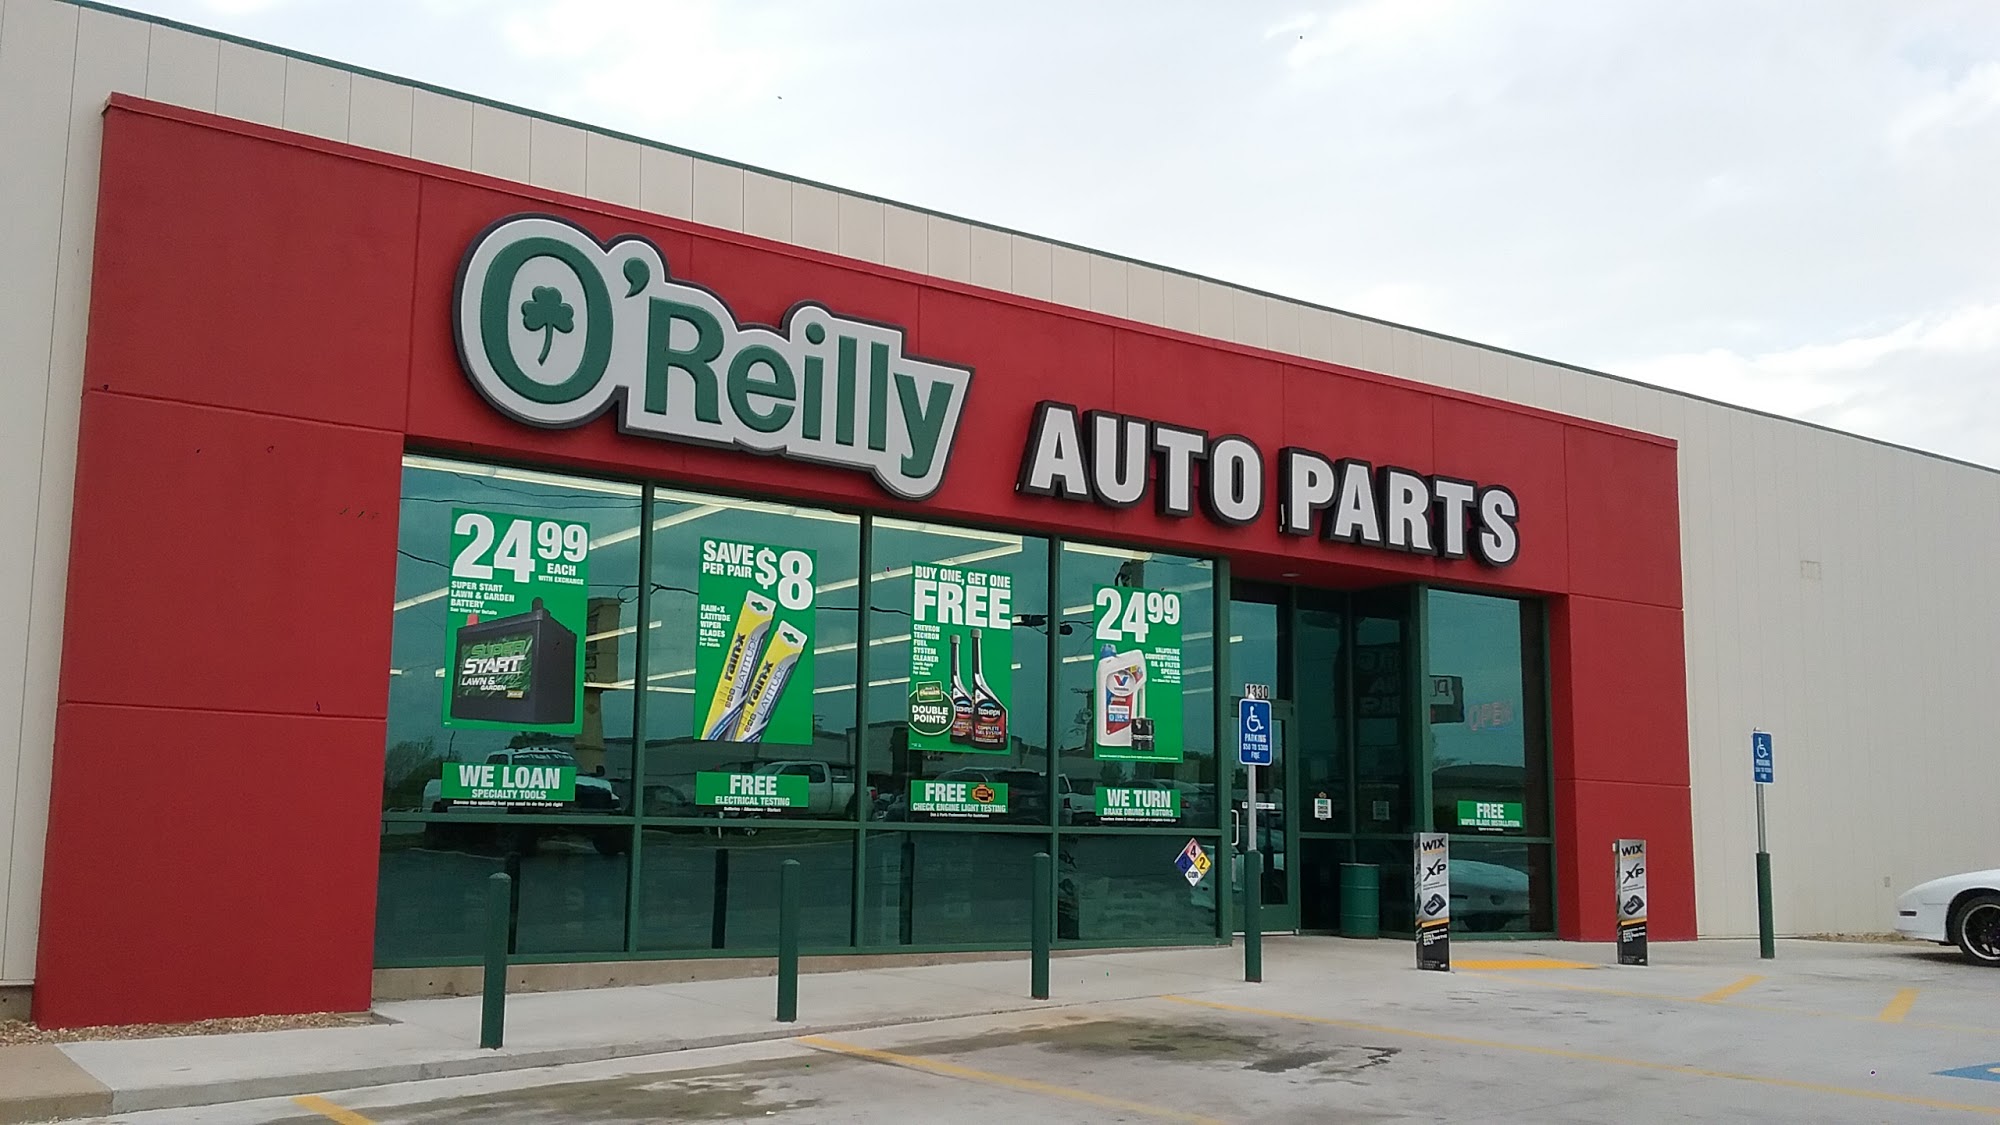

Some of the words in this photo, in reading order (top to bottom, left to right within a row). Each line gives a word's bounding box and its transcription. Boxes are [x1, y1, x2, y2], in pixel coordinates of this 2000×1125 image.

[480, 237, 954, 478] O'Reilly
[1029, 407, 1262, 520] AUTO
[1291, 453, 1517, 564] PARTS
[547, 563, 577, 576] EACH
[702, 562, 724, 575] PER
[727, 564, 752, 578] PAIR
[703, 540, 754, 566] SAVE
[755, 547, 814, 610] $8
[915, 565, 937, 579] BUY
[940, 568, 965, 585] ONE,
[967, 572, 987, 586] GET
[990, 575, 1011, 588] ONE
[451, 581, 477, 590] SUPER
[479, 583, 503, 592] START
[450, 589, 473, 598] LAWN
[475, 591, 482, 599] &
[483, 592, 515, 602] GARDEN
[450, 598, 485, 608] BATTERY
[914, 579, 1011, 630] FREE
[700, 612, 731, 622] LATITUDE
[700, 621, 722, 629] WIPER
[913, 623, 940, 632] CHEVRON
[699, 628, 726, 638] BLADES
[913, 631, 940, 640] TECHRON
[913, 639, 928, 647] FUEL
[913, 647, 936, 655] SYSTEM
[462, 654, 527, 674] START
[736, 636, 758, 690] LATITUDE
[913, 654, 939, 663] CLEANER
[461, 677, 487, 686] LAWN
[487, 676, 495, 685] &
[757, 665, 786, 717] LATITUDE
[1246, 684, 1269, 698] 1330
[912, 705, 949, 715] DOUBLE
[913, 714, 947, 724] POINTS
[1244, 733, 1267, 742] PARKING
[459, 765, 495, 787] WE
[502, 766, 560, 789] LOAN
[730, 774, 777, 795] FREE
[472, 789, 517, 799] SPECIALTY
[519, 790, 547, 800] TOOLS
[925, 783, 966, 802] FREE
[1107, 789, 1130, 807] WE
[1133, 790, 1171, 808] TURN
[715, 795, 759, 805] ELECTRICAL
[760, 797, 790, 806] TESTING
[913, 803, 935, 811] CHECK
[936, 803, 960, 812] ENGINE
[961, 804, 979, 812] LIGHT
[981, 804, 1006, 812] TESTING
[1124, 808, 1144, 816] DRUMS
[1151, 809, 1173, 817] ROTORS
[1476, 803, 1504, 819] FREE
[1422, 838, 1445, 851] WIX
[1621, 844, 1643, 857] WIX
[1190, 845, 1196, 858] 4
[1199, 857, 1206, 869] 2
